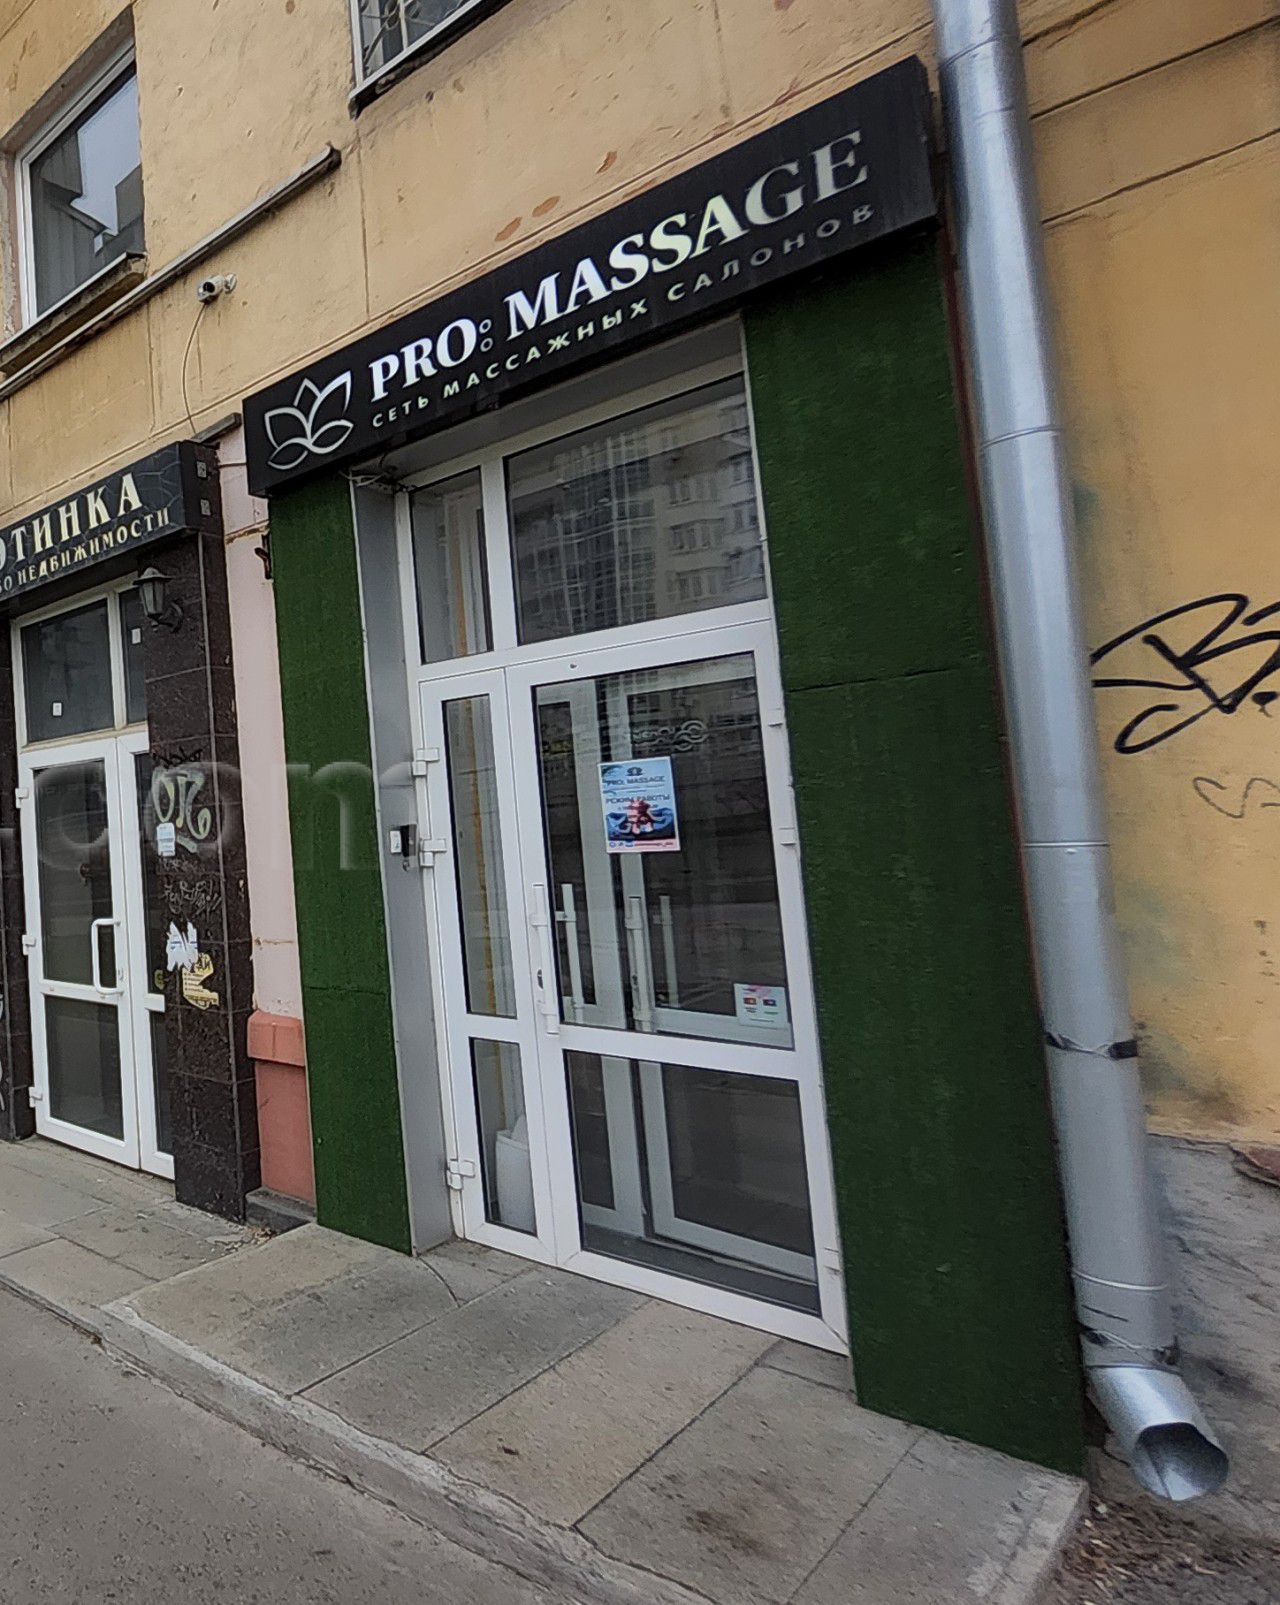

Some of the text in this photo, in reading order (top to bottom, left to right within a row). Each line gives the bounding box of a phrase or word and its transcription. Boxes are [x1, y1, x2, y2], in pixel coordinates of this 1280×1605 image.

[372, 204, 875, 428] СЕТЬ МАССАЖНЫХ САЛОНОВ
[503, 130, 869, 342] MASSAGE
[17, 506, 172, 587] НЕДВИЖИМОСТИ
